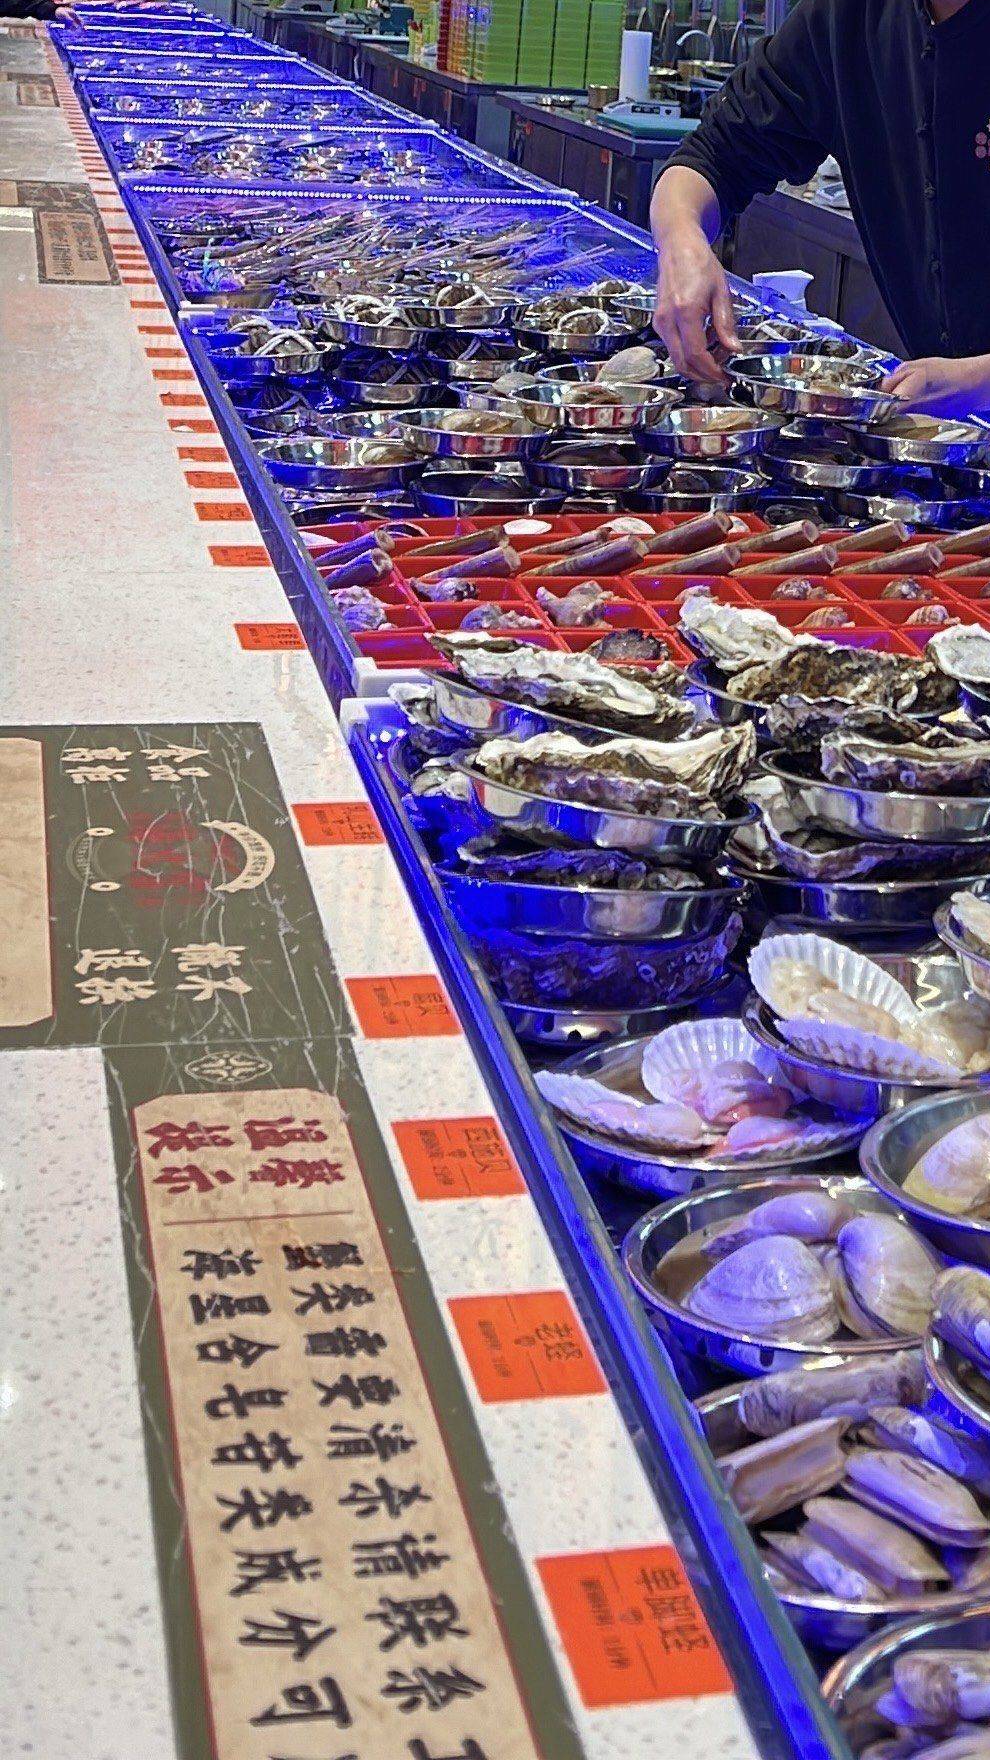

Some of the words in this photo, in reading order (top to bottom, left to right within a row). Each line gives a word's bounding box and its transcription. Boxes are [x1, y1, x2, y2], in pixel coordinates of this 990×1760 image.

[144, 1120, 238, 1195] 提示
[242, 1115, 347, 1190] 温馨
[180, 1248, 357, 1760] 海星含皂苷类成分可
